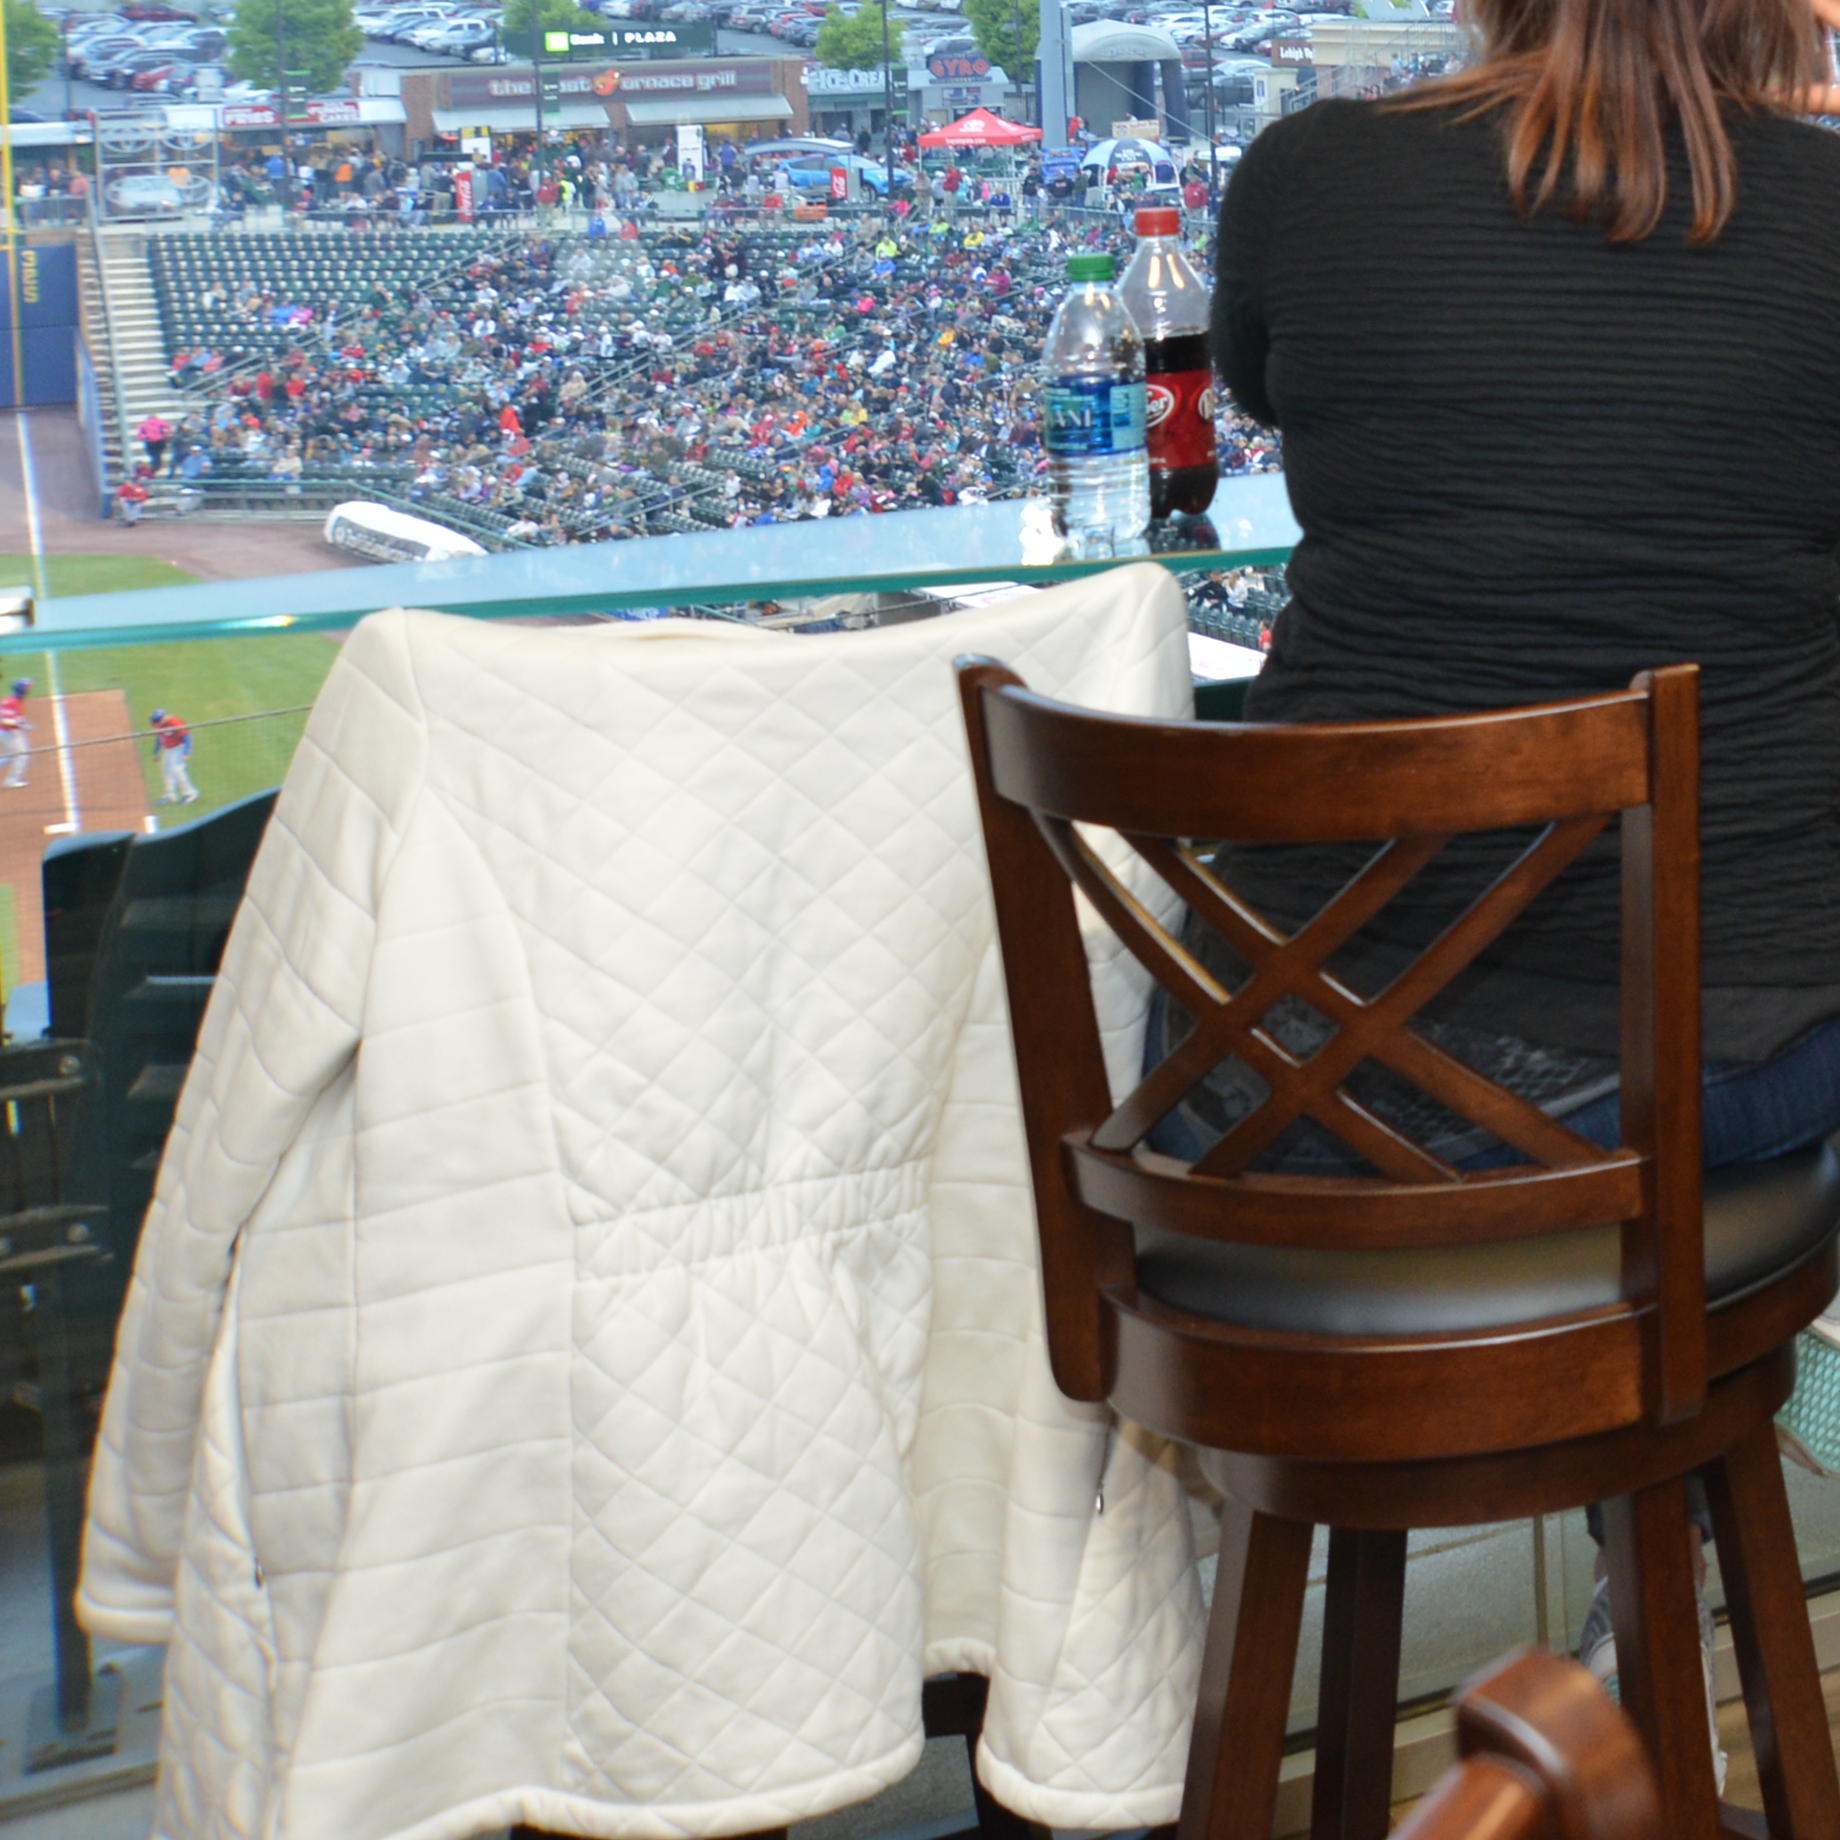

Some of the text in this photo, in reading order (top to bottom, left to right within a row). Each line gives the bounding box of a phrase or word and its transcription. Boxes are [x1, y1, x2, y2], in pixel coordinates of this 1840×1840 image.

[624, 31, 677, 44] PLAZA
[1279, 46, 1304, 62] Lehigh
[930, 58, 990, 78] GYRO
[489, 78, 532, 96] the
[697, 71, 738, 93] grill
[819, 68, 886, 90] ICE CREA
